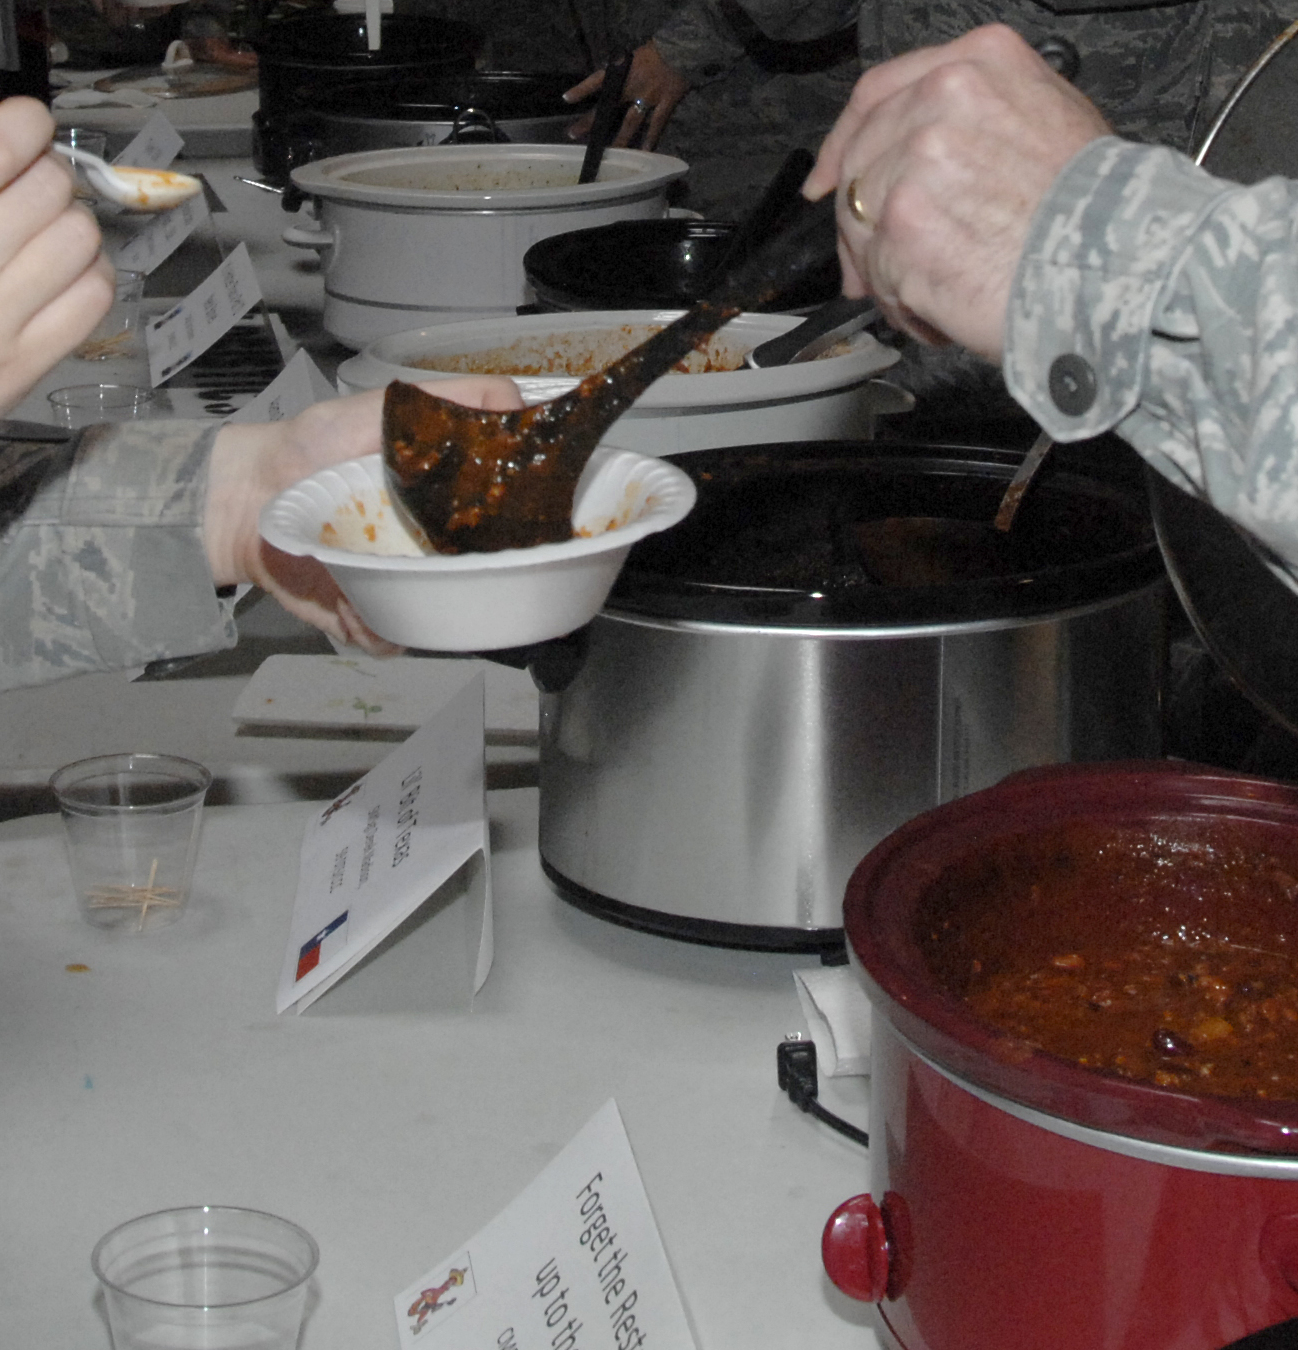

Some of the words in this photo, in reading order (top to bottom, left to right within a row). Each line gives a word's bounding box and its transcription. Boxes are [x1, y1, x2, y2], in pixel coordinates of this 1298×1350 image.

[391, 817, 418, 868] Texas
[576, 1172, 618, 1262] Forget
[598, 1248, 628, 1305] the
[531, 1257, 561, 1298] up
[544, 1287, 570, 1327] to
[551, 1318, 584, 1350] th
